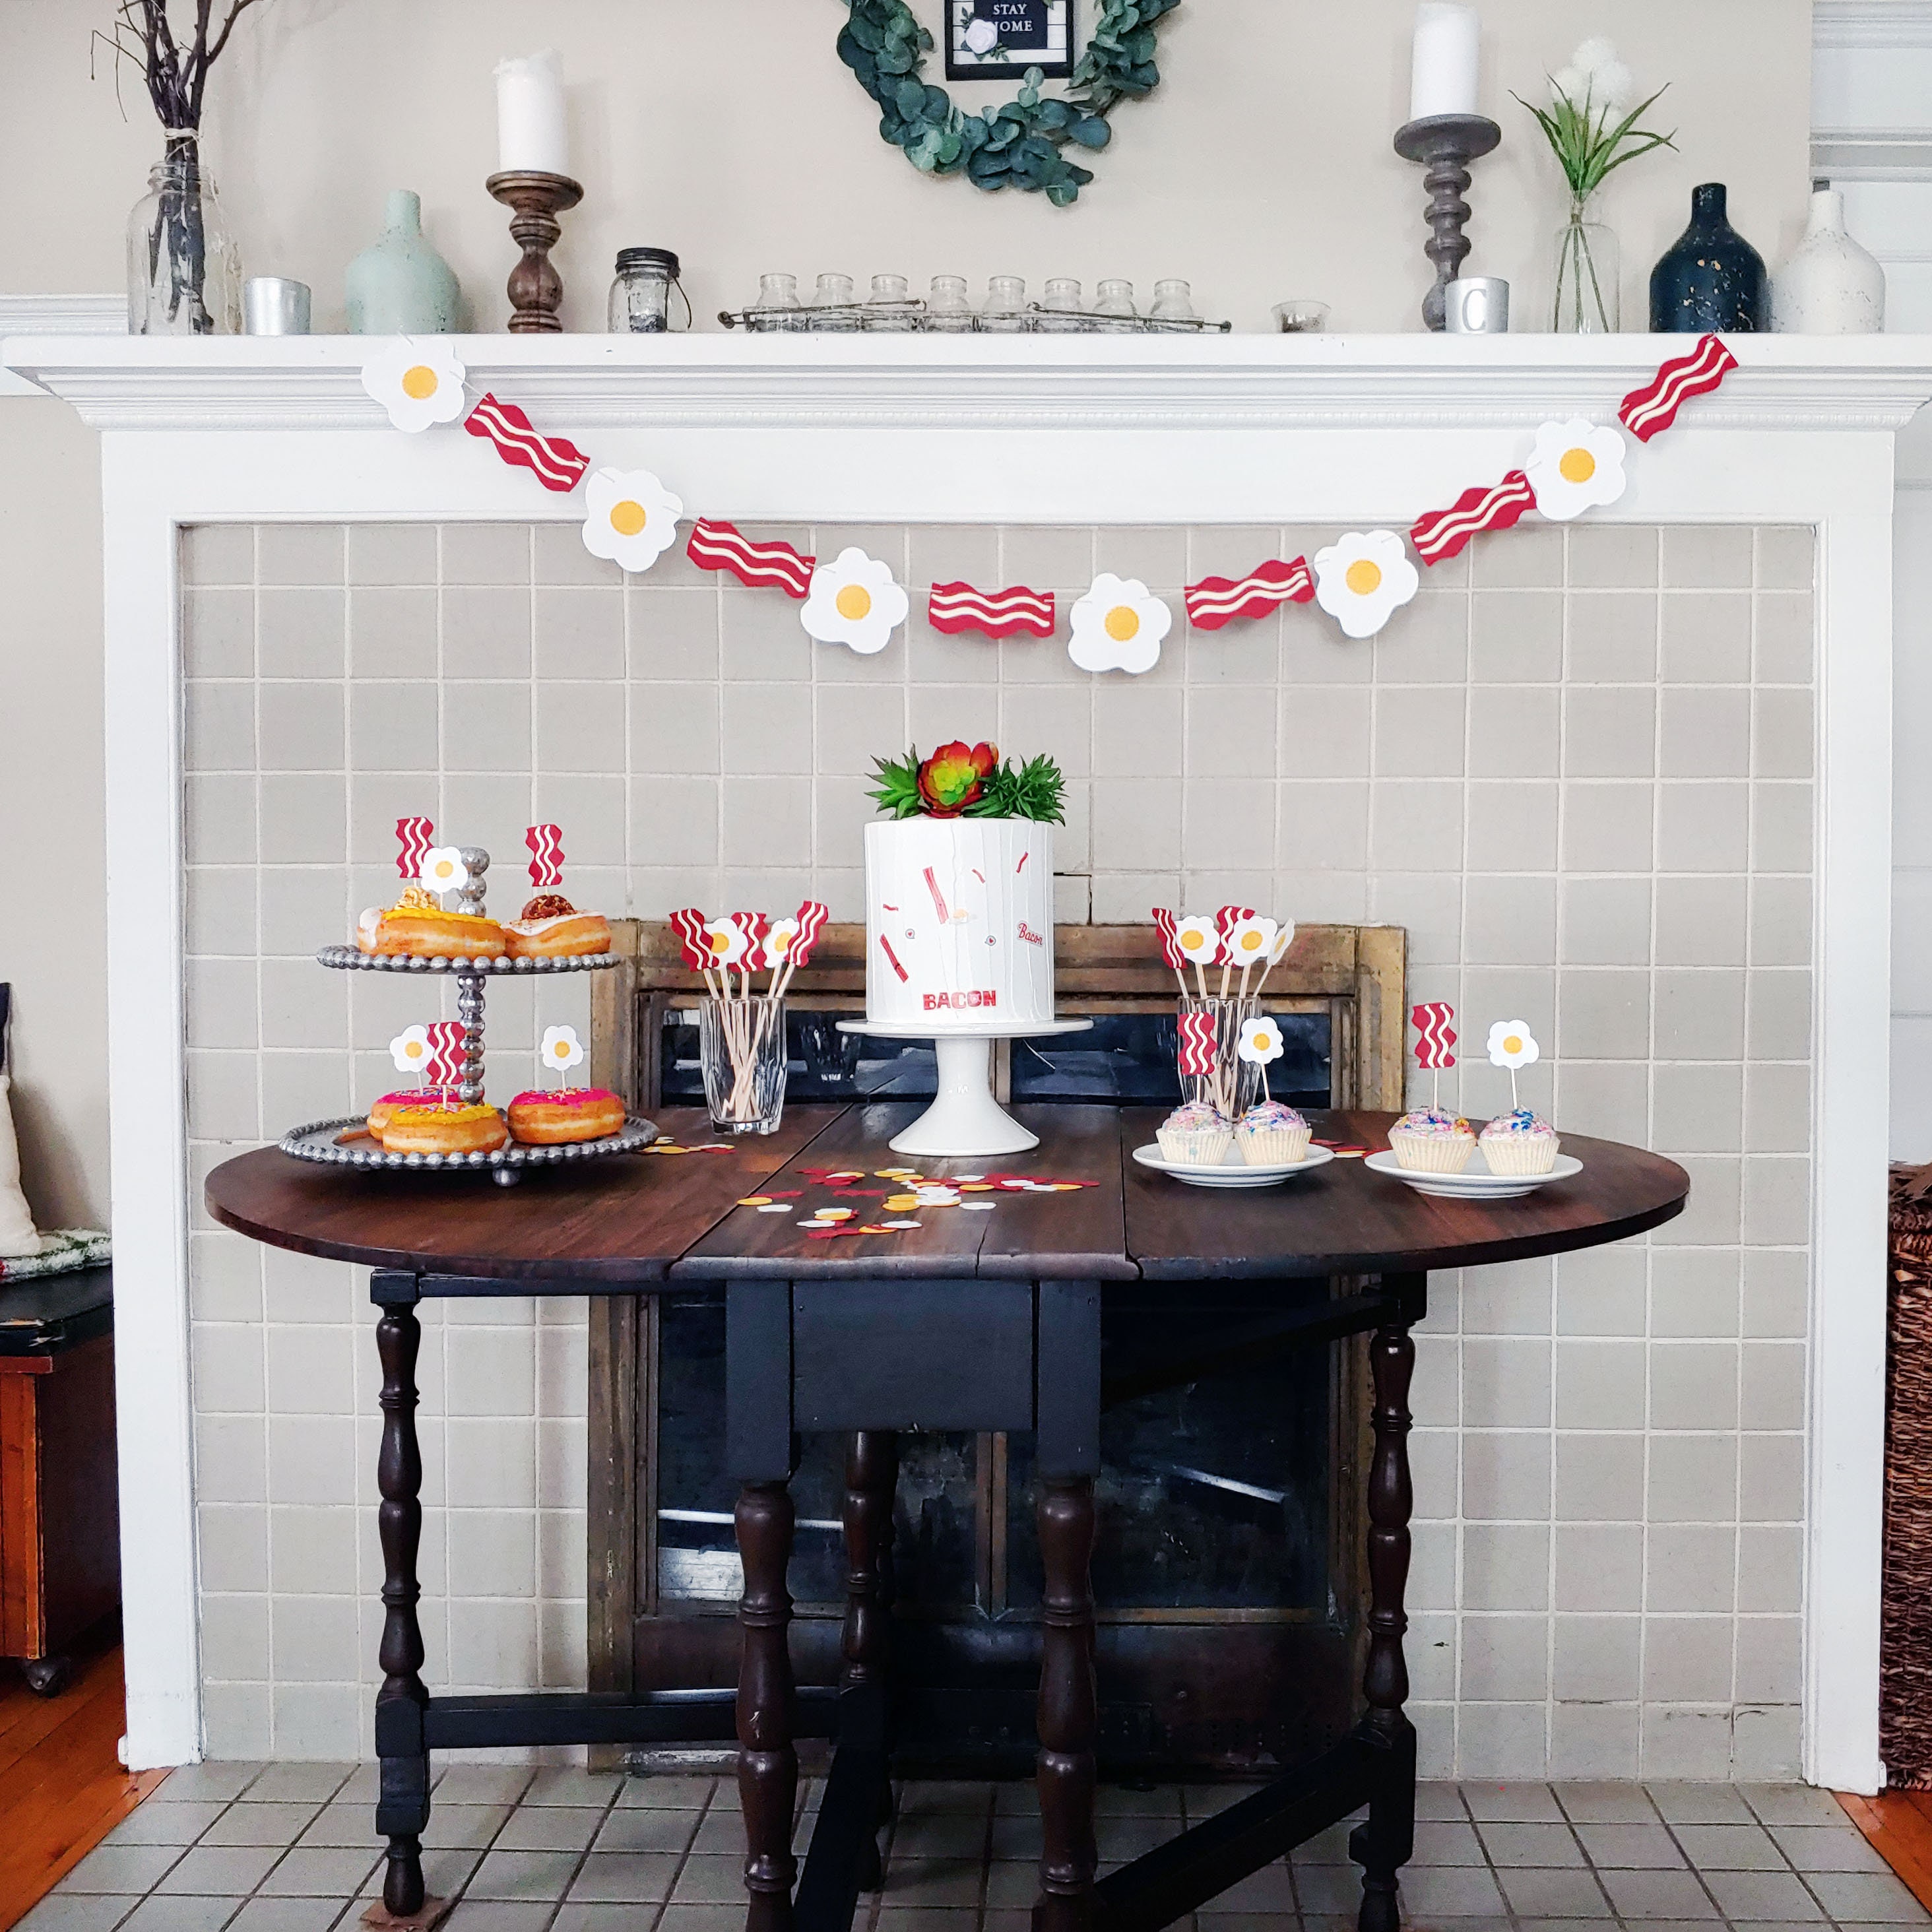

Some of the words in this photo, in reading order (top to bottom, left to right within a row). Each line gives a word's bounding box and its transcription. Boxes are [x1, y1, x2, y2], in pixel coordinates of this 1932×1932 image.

[992, 3, 1027, 15] STAY
[994, 20, 1033, 32] OME
[1462, 288, 1487, 331] C
[1018, 922, 1043, 946] Bacon
[922, 990, 996, 1010] BACON
